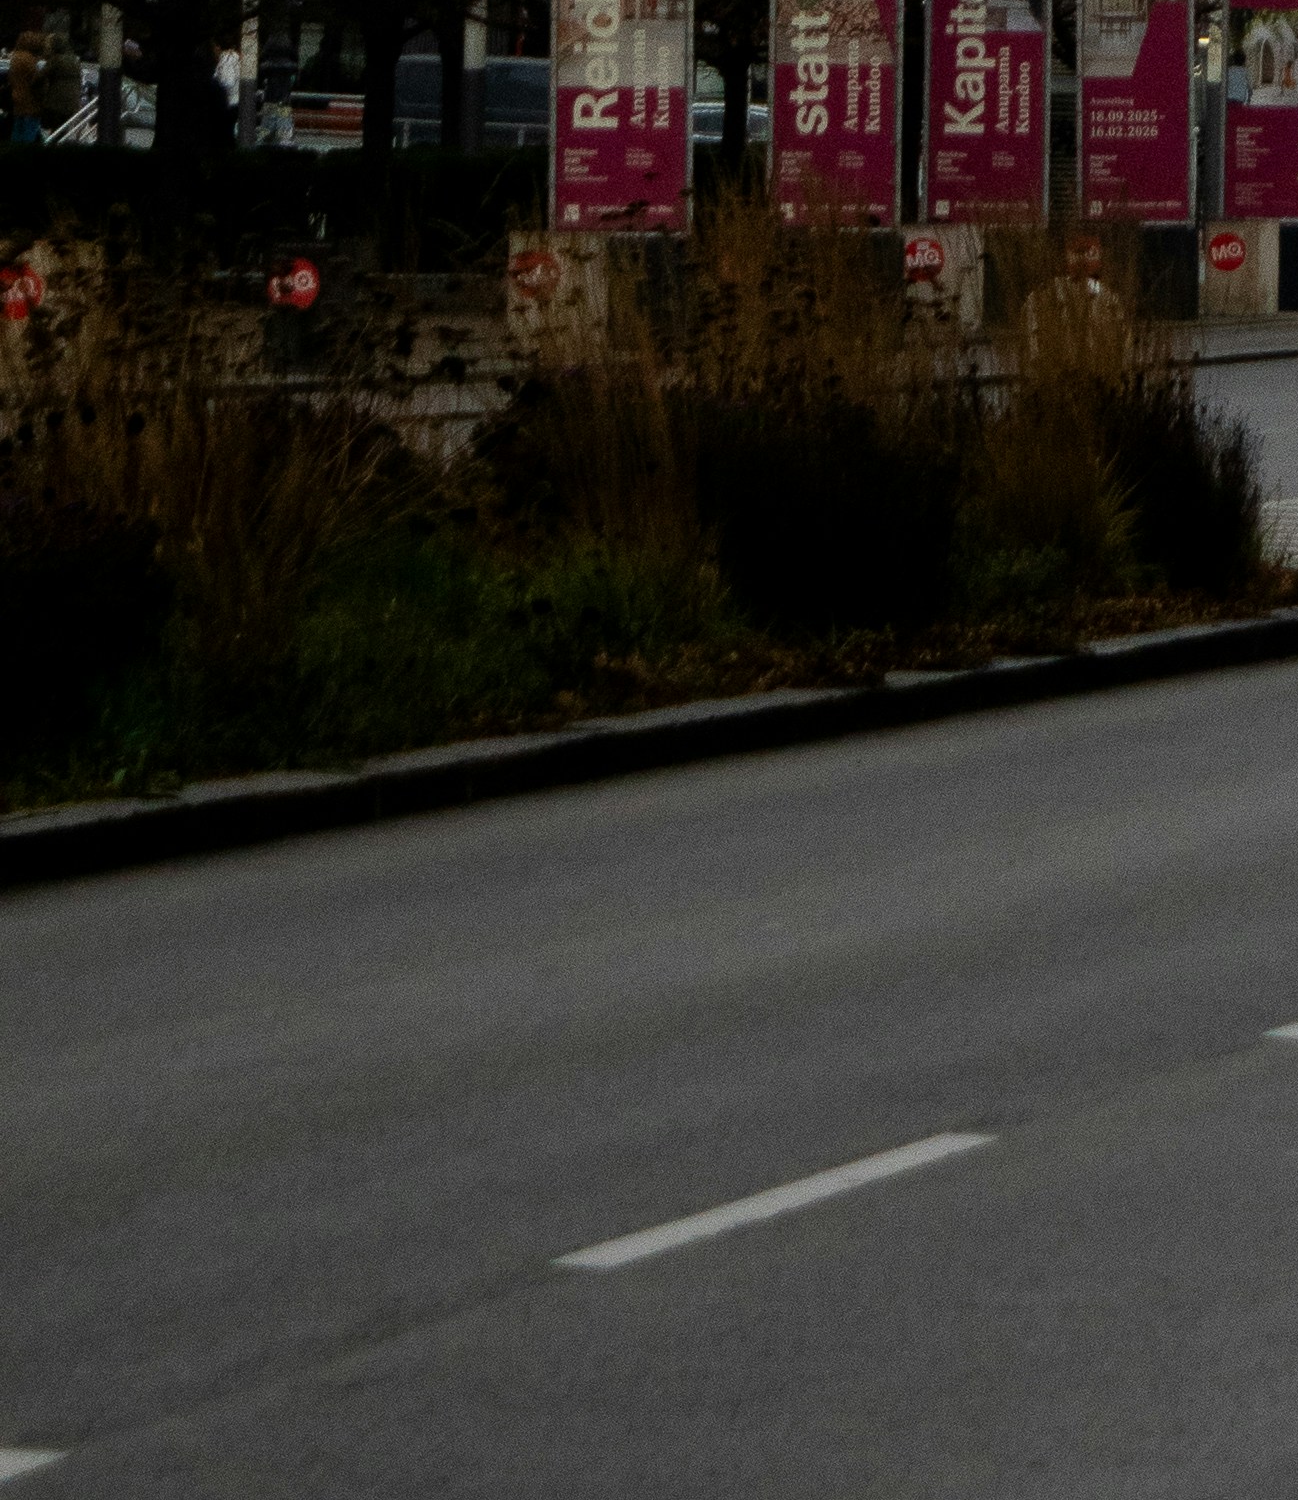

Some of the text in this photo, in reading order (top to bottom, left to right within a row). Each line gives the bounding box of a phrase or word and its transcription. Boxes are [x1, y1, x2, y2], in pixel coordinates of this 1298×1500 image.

[788, 10, 830, 136] statt
[842, 37, 862, 132] Anupama
[864, 56, 882, 134] Kundoo
[994, 45, 1014, 135] Anupama
[1014, 61, 1031, 135] Kundoo
[1211, 242, 1244, 262] MQ
